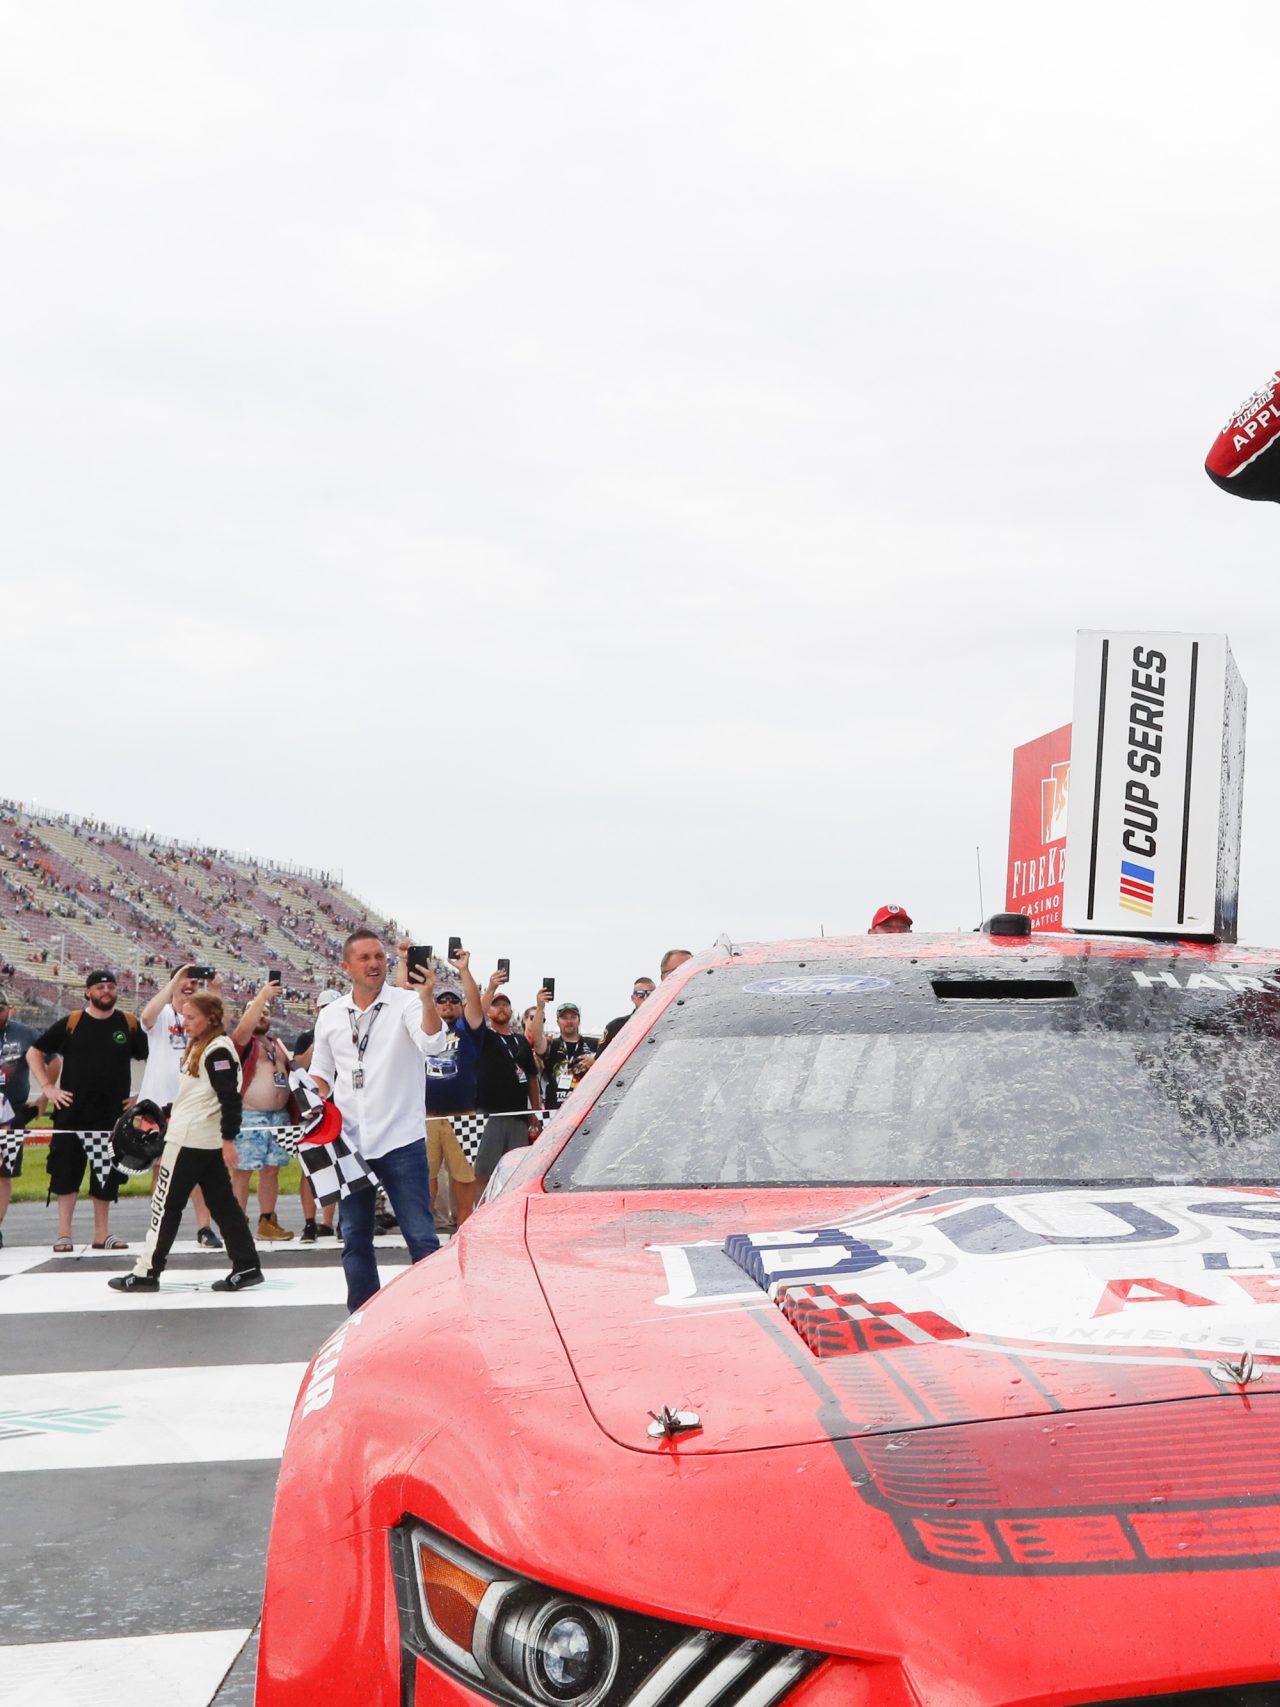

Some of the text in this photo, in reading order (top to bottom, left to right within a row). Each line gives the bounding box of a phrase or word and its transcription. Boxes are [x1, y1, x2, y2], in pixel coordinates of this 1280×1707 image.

[1122, 645, 1167, 858] CUP SERIES
[1020, 895, 1060, 917] CASINO
[1030, 912, 1059, 929] BATTLE
